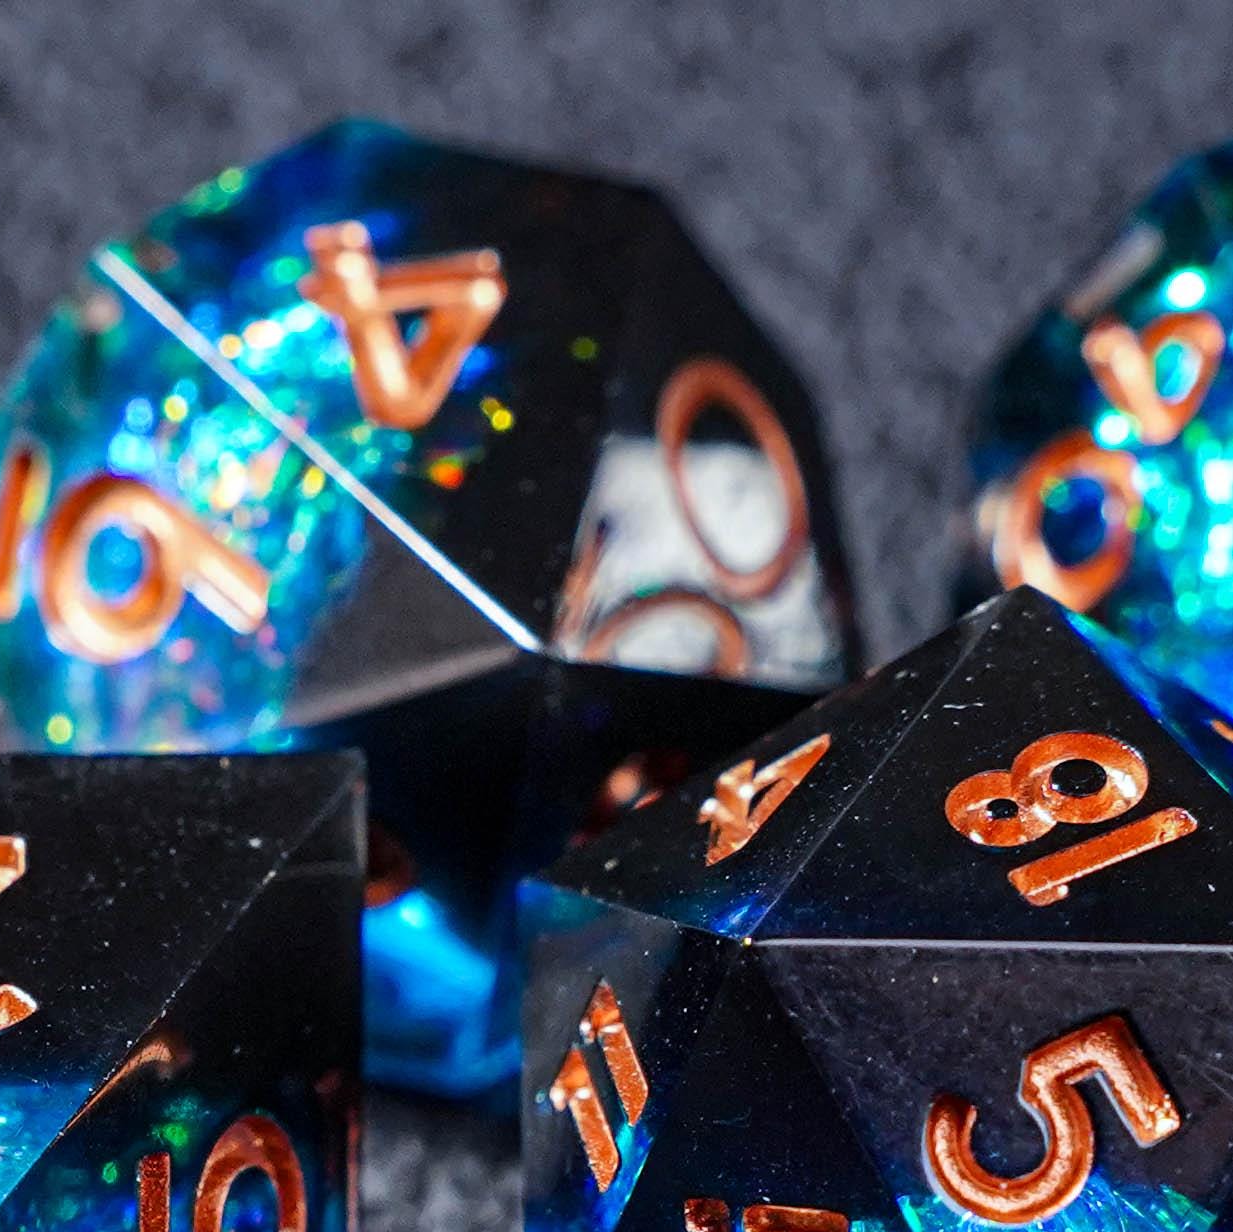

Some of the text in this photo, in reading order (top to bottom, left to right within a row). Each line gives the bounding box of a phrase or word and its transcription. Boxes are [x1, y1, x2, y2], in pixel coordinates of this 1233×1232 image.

[298, 218, 508, 429] 4
[945, 730, 1198, 907] 18
[922, 1012, 1180, 1227] 5
